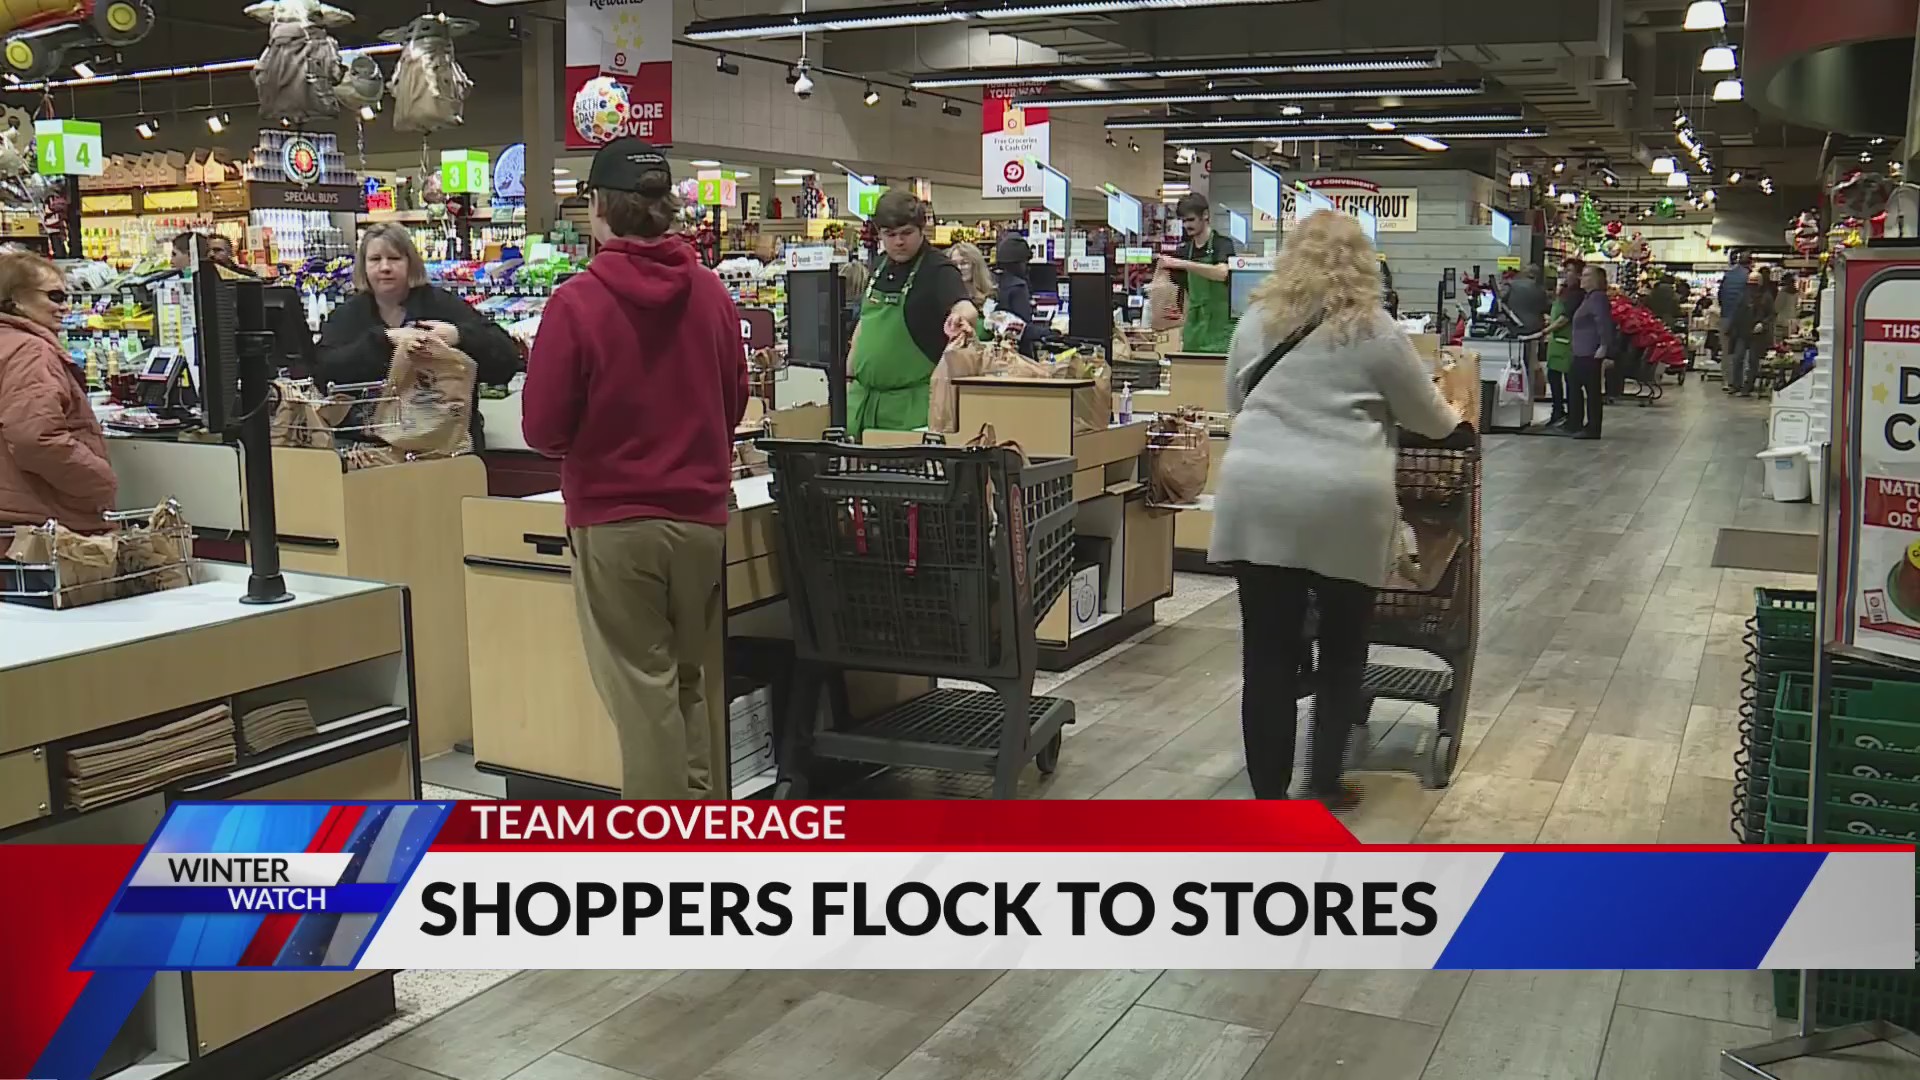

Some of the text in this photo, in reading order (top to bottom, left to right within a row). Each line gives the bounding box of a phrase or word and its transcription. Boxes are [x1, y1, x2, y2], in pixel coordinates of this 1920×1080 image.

[990, 87, 1043, 98] YOUR WAY
[578, 112, 595, 125] DAY
[629, 103, 663, 119] ORE
[45, 139, 57, 168] 4
[75, 142, 90, 169] 4
[448, 165, 460, 188] 3
[473, 167, 482, 187] 3
[1323, 179, 1375, 190] CONVENIENT
[284, 191, 338, 203] SPECIAL BUYS
[703, 181, 715, 201] 2
[996, 184, 1032, 195] Rewards
[1882, 324, 1920, 339] THIS
[1888, 512, 1913, 528] OR
